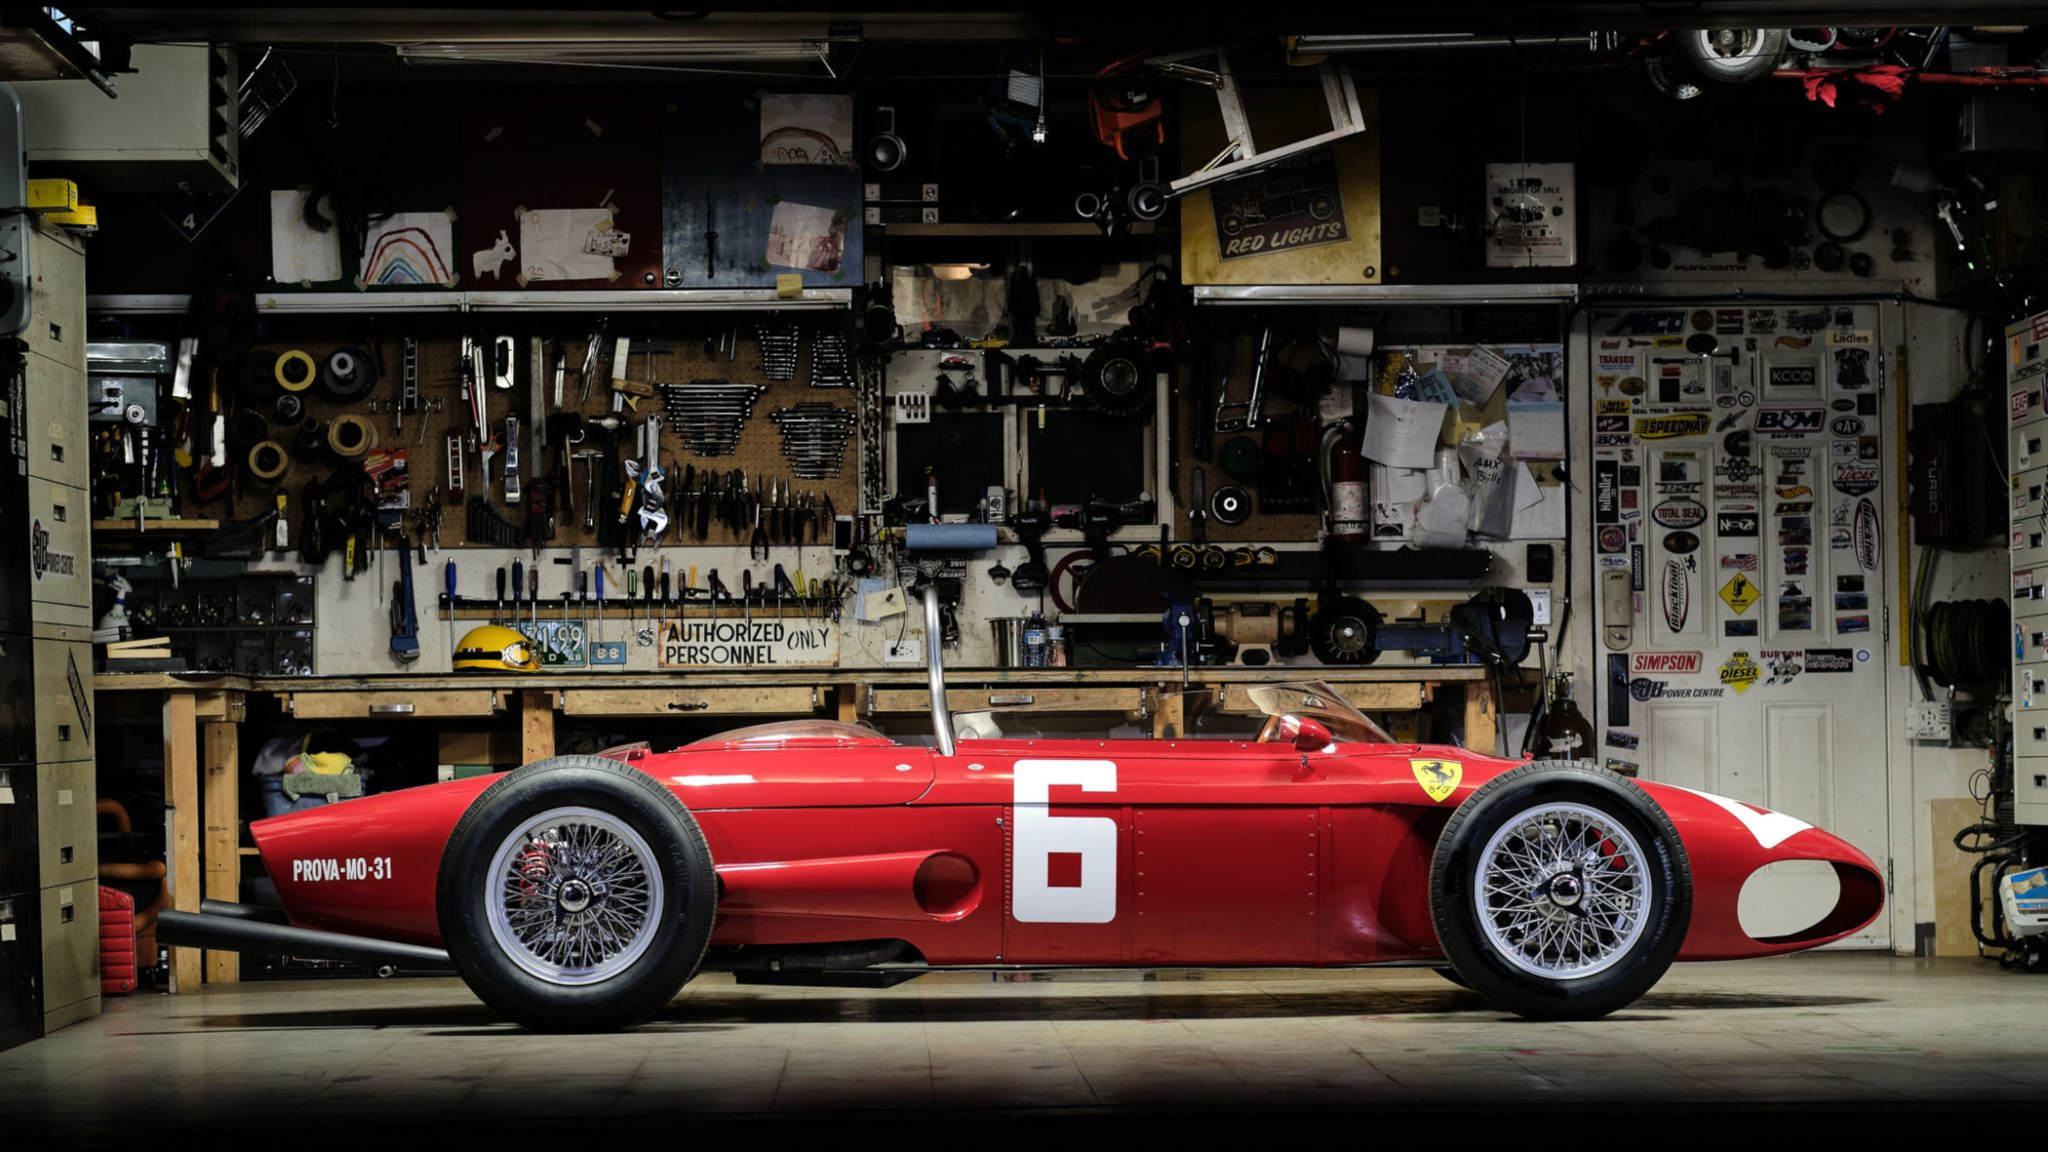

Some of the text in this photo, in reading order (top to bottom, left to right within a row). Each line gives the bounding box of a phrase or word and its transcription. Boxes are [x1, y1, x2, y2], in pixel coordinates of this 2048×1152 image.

[182, 212, 196, 230] 4
[1226, 221, 1341, 255] RED LIGHTS
[1833, 334, 1869, 344] Ladies
[1772, 370, 1813, 382] KCCO
[1648, 417, 1708, 433] SPEEDWAY
[1757, 409, 1820, 429] B&M
[1835, 420, 1858, 432] RAT
[1476, 470, 1502, 485] Bills
[1838, 470, 1876, 480] LUCAS
[1928, 457, 1938, 514] TURBO
[1657, 507, 1702, 519] TOTAL SEAL
[667, 622, 830, 650] AUTHORIZED ONLY
[666, 645, 778, 665] PERSONNEL
[1760, 650, 1803, 658] BURTON
[1635, 654, 1696, 671] SIMPSON
[1720, 667, 1758, 680] DIESEL
[1662, 688, 1691, 698] POWER
[1693, 688, 1725, 698] CENTRE
[1012, 759, 1118, 924] 6
[292, 856, 393, 882] PROVA-MO-31
[1655, 836, 1675, 889] DUNLOP
